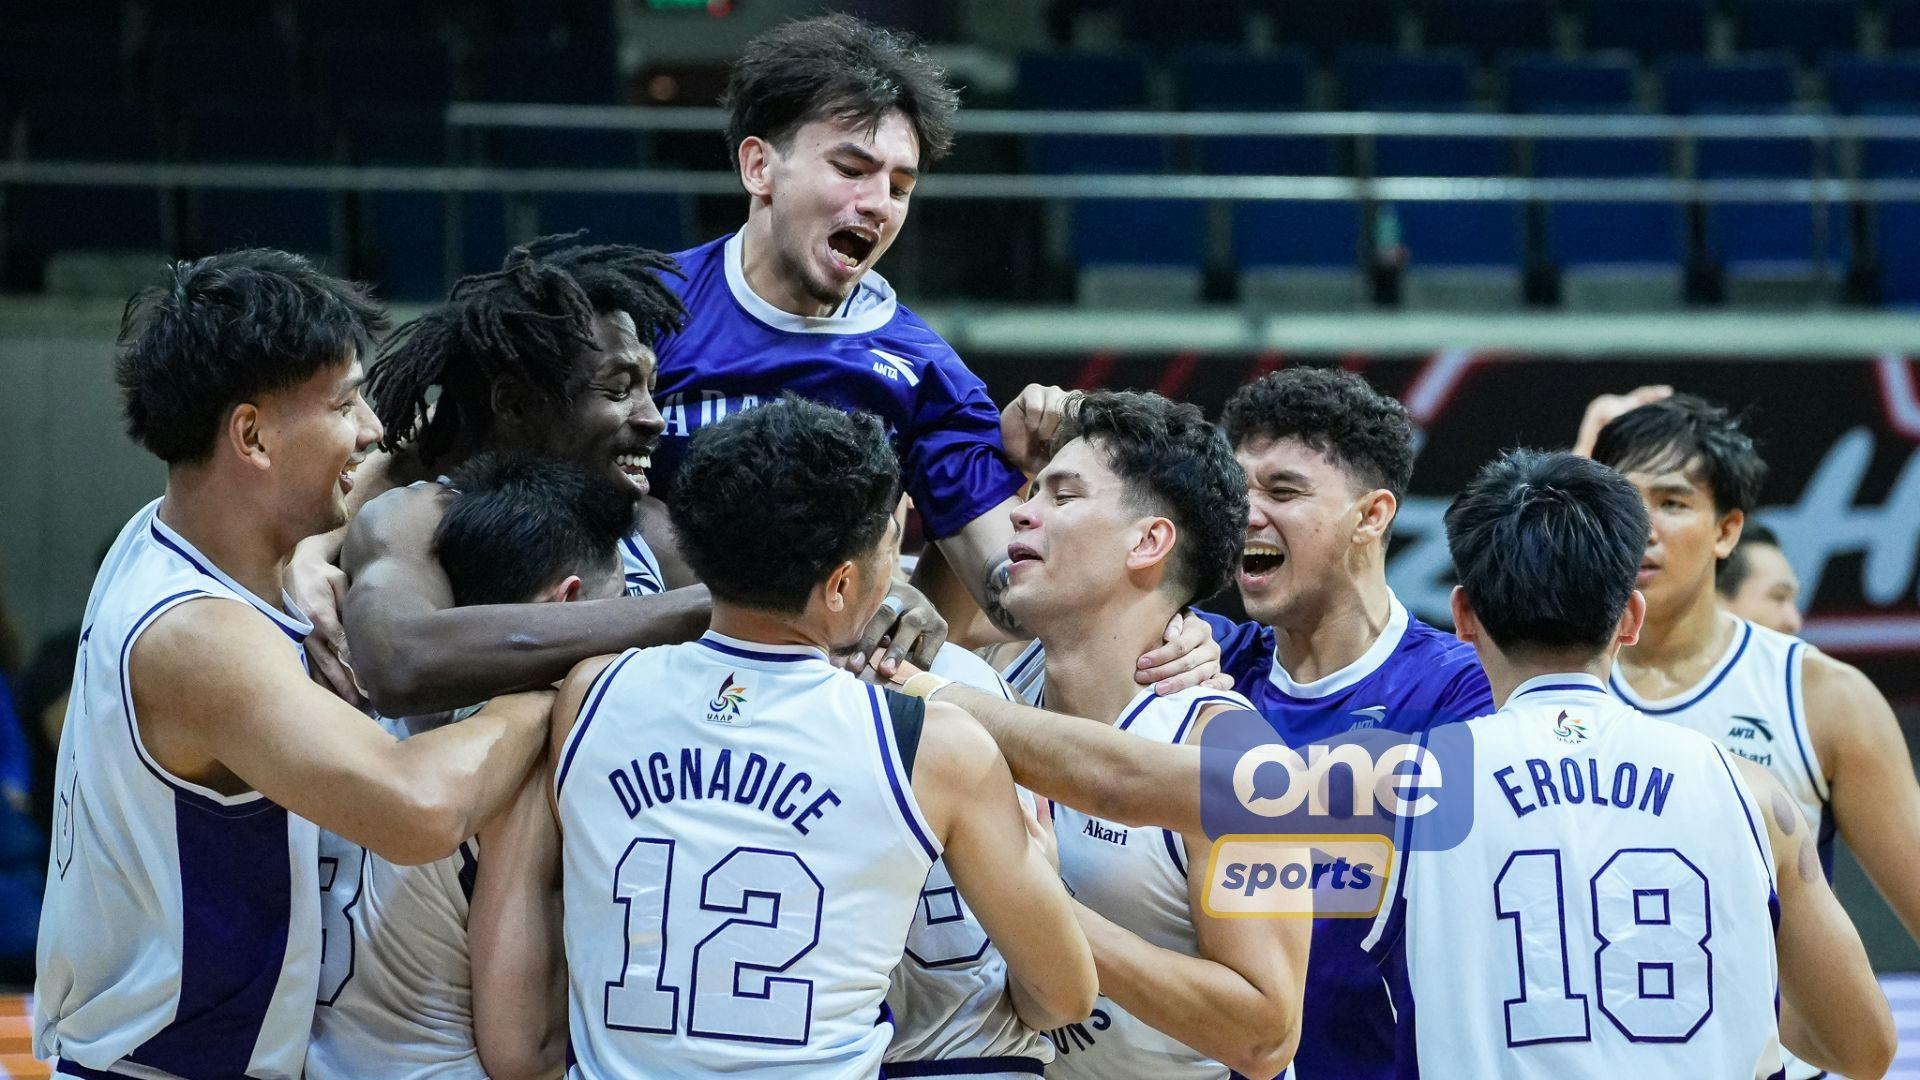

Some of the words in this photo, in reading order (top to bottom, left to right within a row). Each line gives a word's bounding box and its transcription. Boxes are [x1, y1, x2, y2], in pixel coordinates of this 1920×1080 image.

[872, 361, 898, 381] ANTA
[706, 713, 733, 721] UAAP
[1728, 727, 1755, 739] ANTA
[608, 748, 842, 835] DIGNADICE
[1493, 757, 1674, 818] EROLON
[1083, 819, 1128, 846] Akari
[604, 837, 825, 1046] 12
[1493, 848, 1713, 1048] 18
